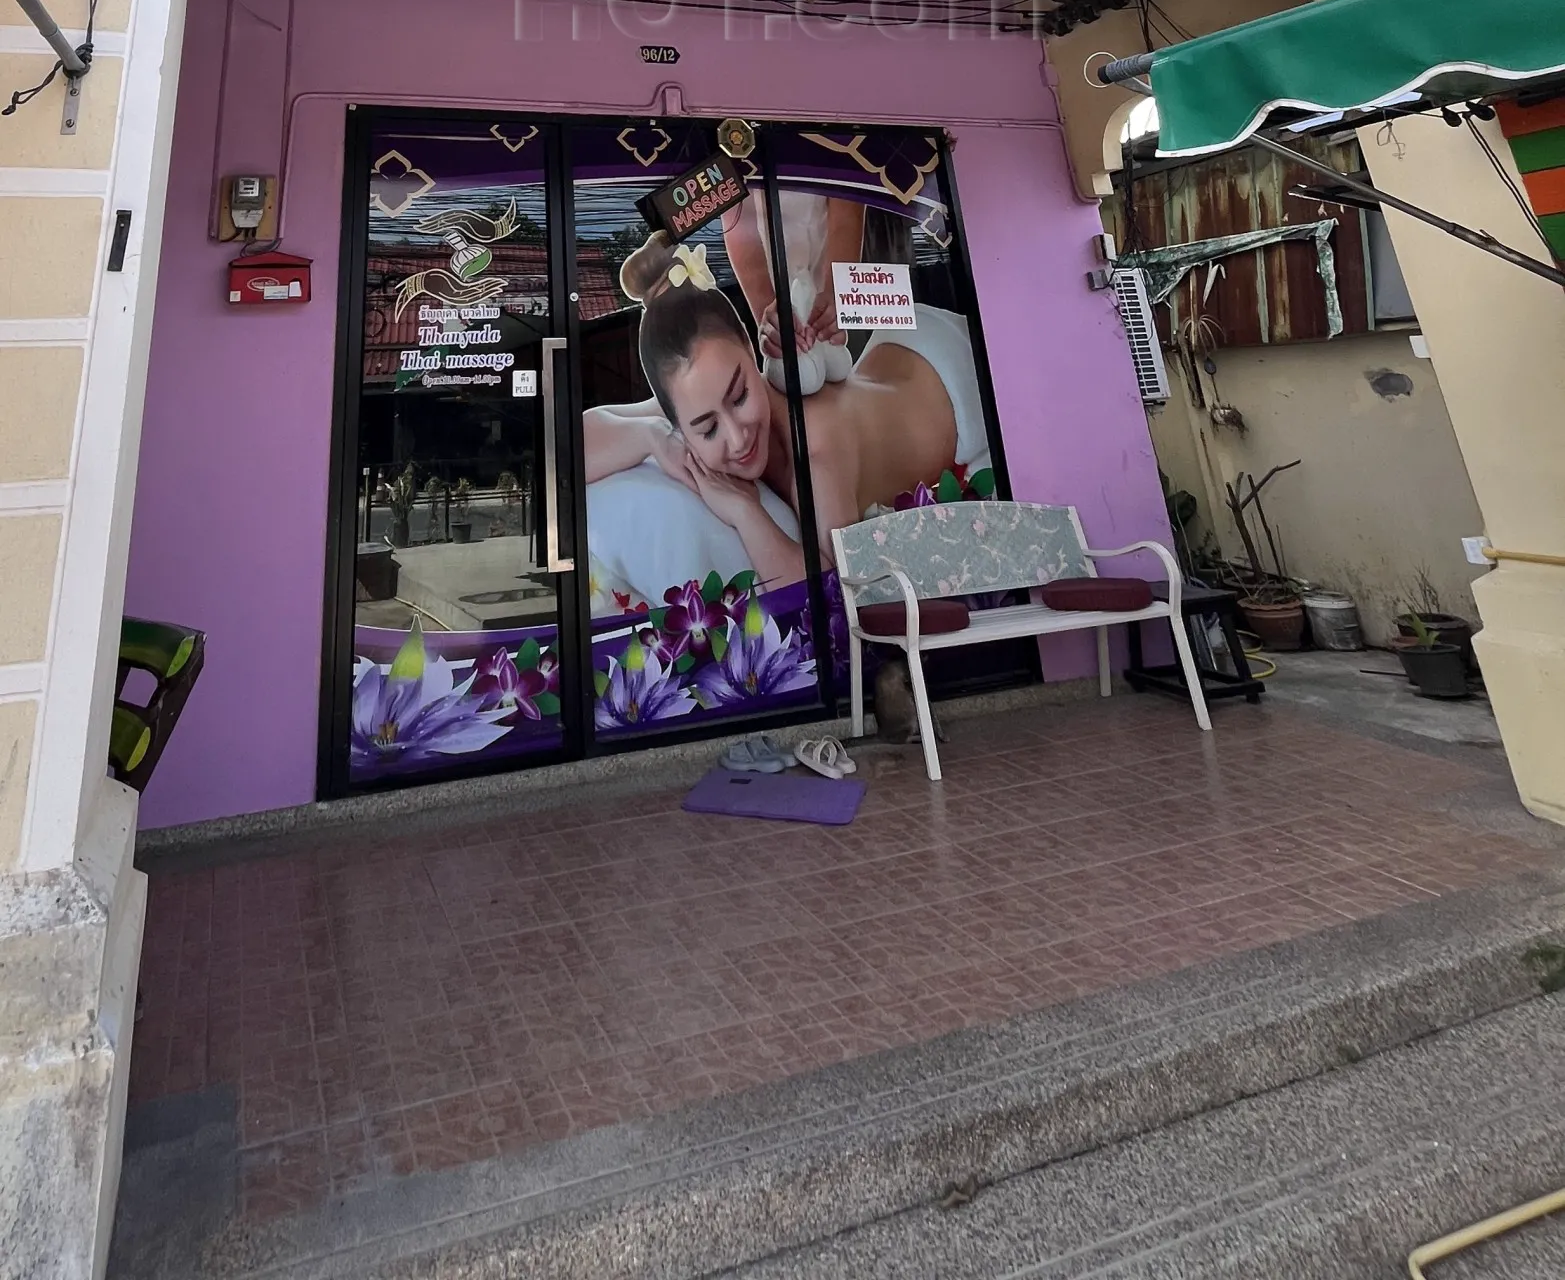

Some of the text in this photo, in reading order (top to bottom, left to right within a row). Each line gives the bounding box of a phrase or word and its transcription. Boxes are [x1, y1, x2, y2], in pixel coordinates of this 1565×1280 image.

[642, 47, 675, 62] 96/12
[672, 163, 724, 207] OPEN
[672, 177, 740, 233] MASSAGE
[849, 266, 894, 284] รับสมัคร
[839, 288, 910, 306] พนักงานนวด
[840, 312, 863, 324] ติดต่อ
[419, 324, 501, 348] Thanyuda
[400, 350, 514, 371] Thai massage
[515, 386, 535, 394] PULL
